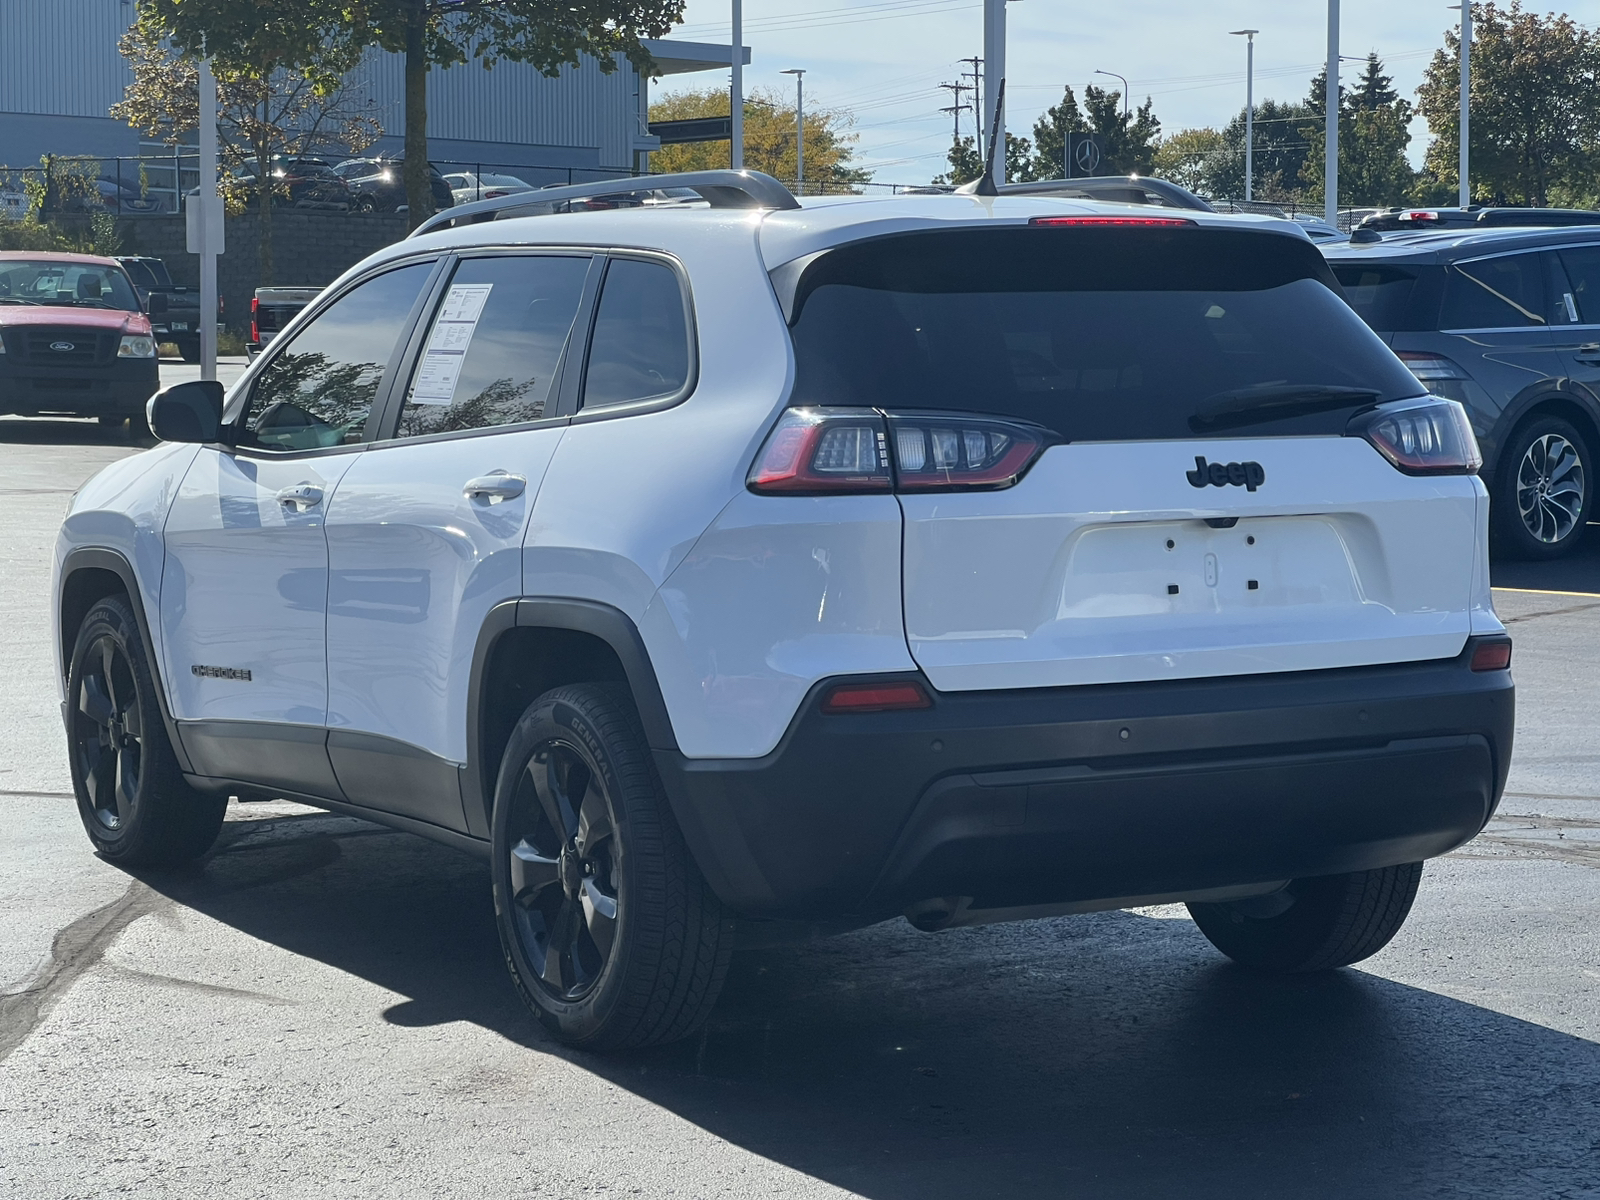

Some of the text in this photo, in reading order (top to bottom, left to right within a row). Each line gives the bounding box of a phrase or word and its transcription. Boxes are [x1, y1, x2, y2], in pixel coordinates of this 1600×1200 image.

[1186, 455, 1265, 492] Jeep
[191, 665, 252, 681] CHEROKEE
[571, 717, 611, 786] GENERAL
